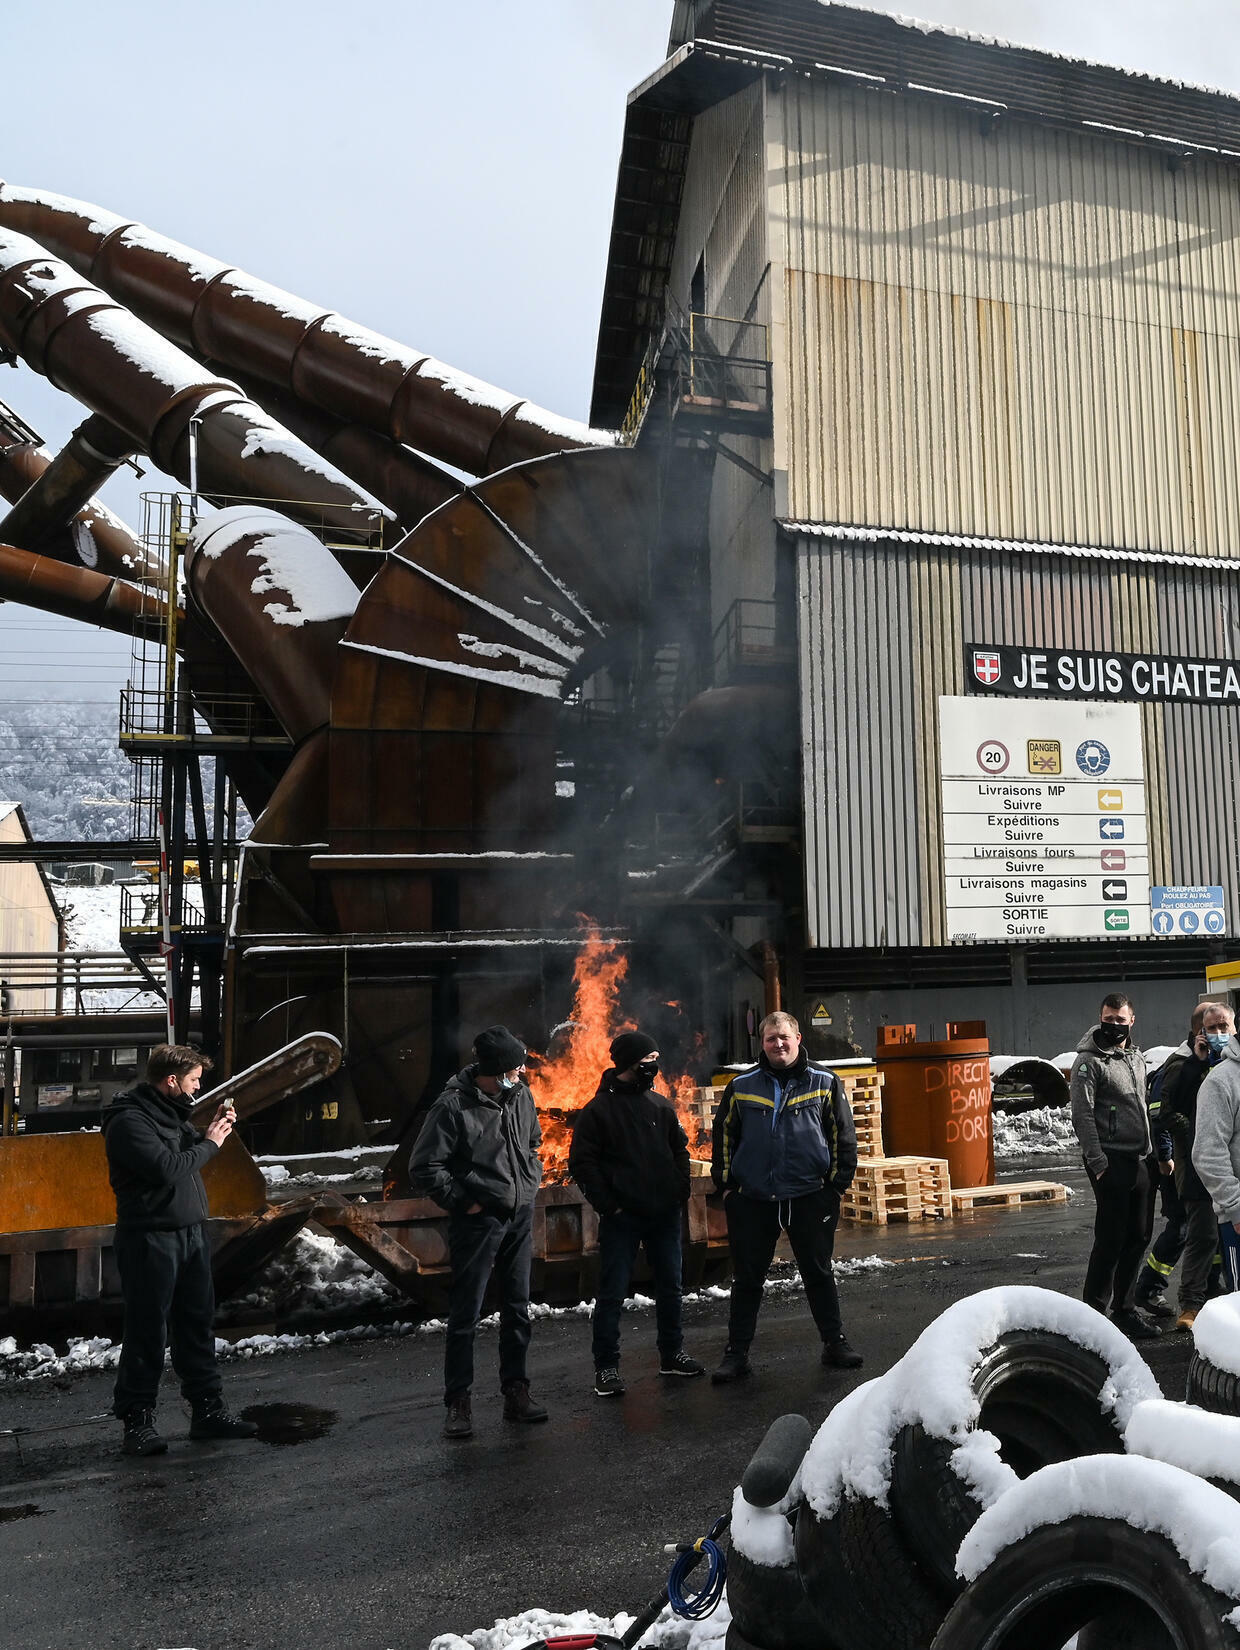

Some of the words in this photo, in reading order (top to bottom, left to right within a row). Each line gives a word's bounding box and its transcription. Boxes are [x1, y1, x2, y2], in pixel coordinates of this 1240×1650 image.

[1012, 653, 1049, 689] JE
[1057, 655, 1124, 694] SUIS
[1029, 742, 1060, 753] DANGER
[985, 752, 1001, 764] 20
[978, 784, 1042, 796] Livraisons
[1047, 785, 1066, 796] MP
[1003, 799, 1043, 810] Suivre
[987, 815, 1060, 828] Expéditions
[1004, 830, 1044, 841] Suivre
[973, 847, 1038, 859] Livraisons
[1044, 847, 1075, 858] fours
[1005, 861, 1045, 872] Suivre
[959, 878, 1025, 889] Livraisons
[1030, 878, 1088, 891] magasins
[1005, 892, 1045, 903] Suivre
[1002, 909, 1049, 920] SORTIE
[1006, 924, 1046, 935] Suivre
